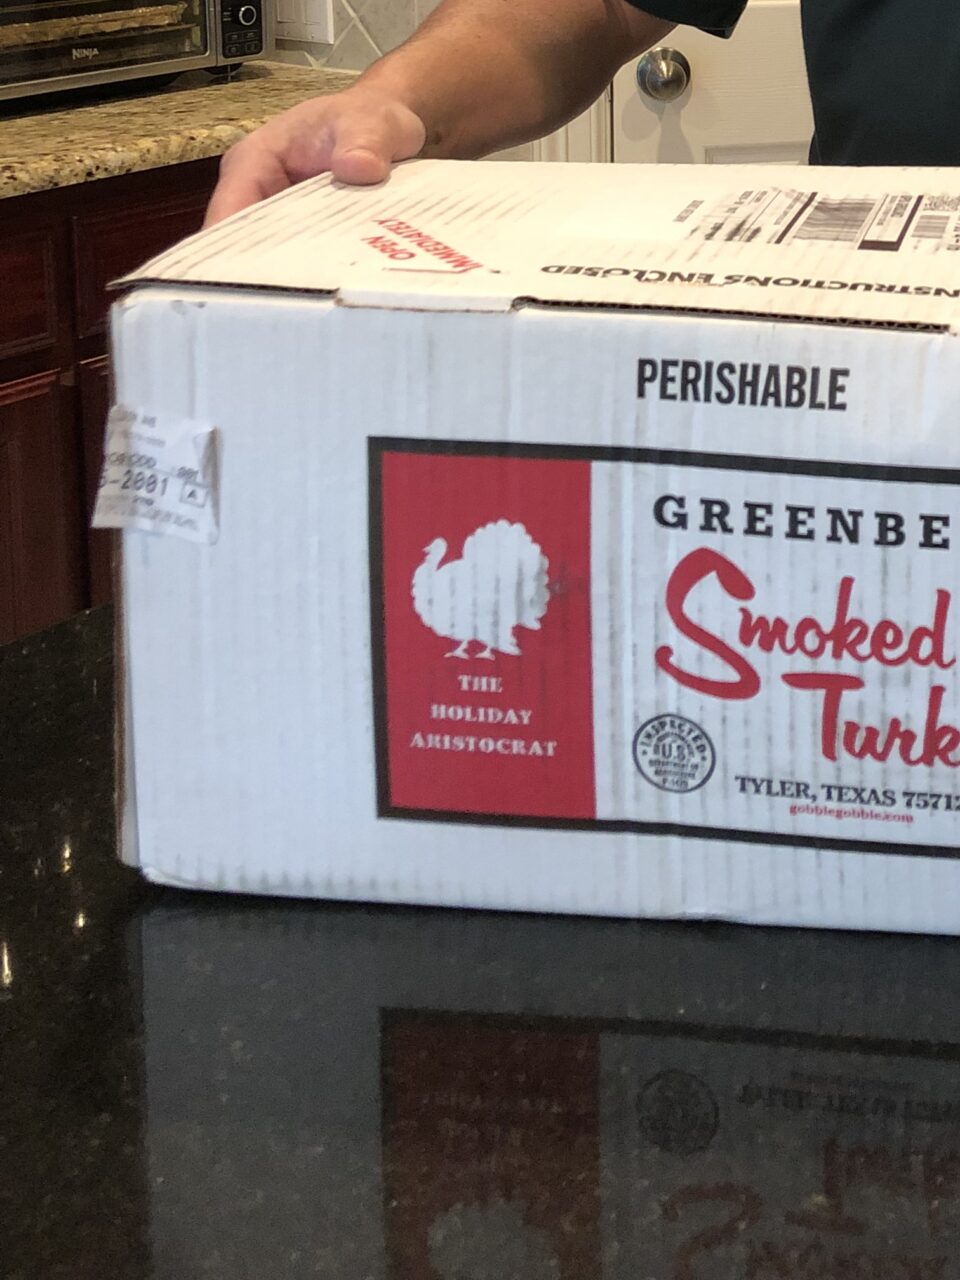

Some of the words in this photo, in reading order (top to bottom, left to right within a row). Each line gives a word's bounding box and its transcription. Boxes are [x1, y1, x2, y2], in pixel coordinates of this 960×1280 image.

[72, 47, 99, 60] NINJA
[361, 234, 416, 261] OPEN
[373, 217, 483, 273] IMMEDIATELY
[540, 263, 718, 286] ENCLOSED
[636, 357, 850, 412] PERISHABLE
[654, 546, 957, 701] Smoked
[458, 674, 504, 694] THE
[431, 703, 533, 726] HOLIDAY
[409, 731, 558, 757] ARISTOCRAT
[734, 774, 818, 803] TYLER,
[820, 782, 897, 807] TEXAS
[788, 803, 915, 825] gobblegobble.com
